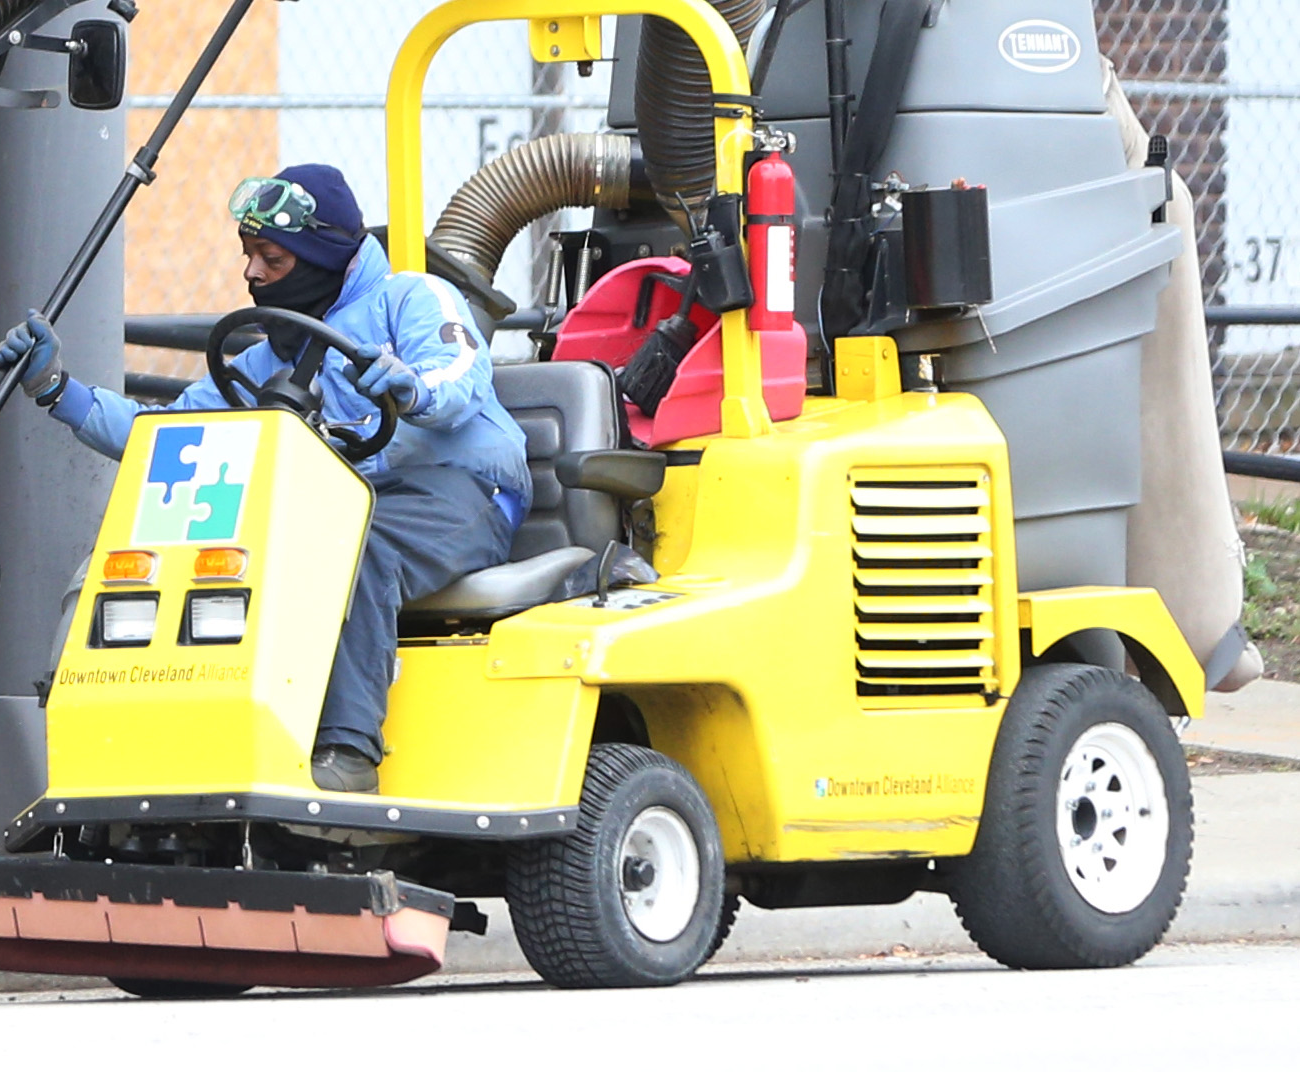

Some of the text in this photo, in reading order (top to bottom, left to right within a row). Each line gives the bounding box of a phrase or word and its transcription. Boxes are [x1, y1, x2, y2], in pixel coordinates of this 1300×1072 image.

[1008, 33, 1070, 59] TENNANT
[59, 664, 249, 685] Downtown Cleveland Alliance
[827, 773, 976, 797] Downtown Cleveland Alliance
